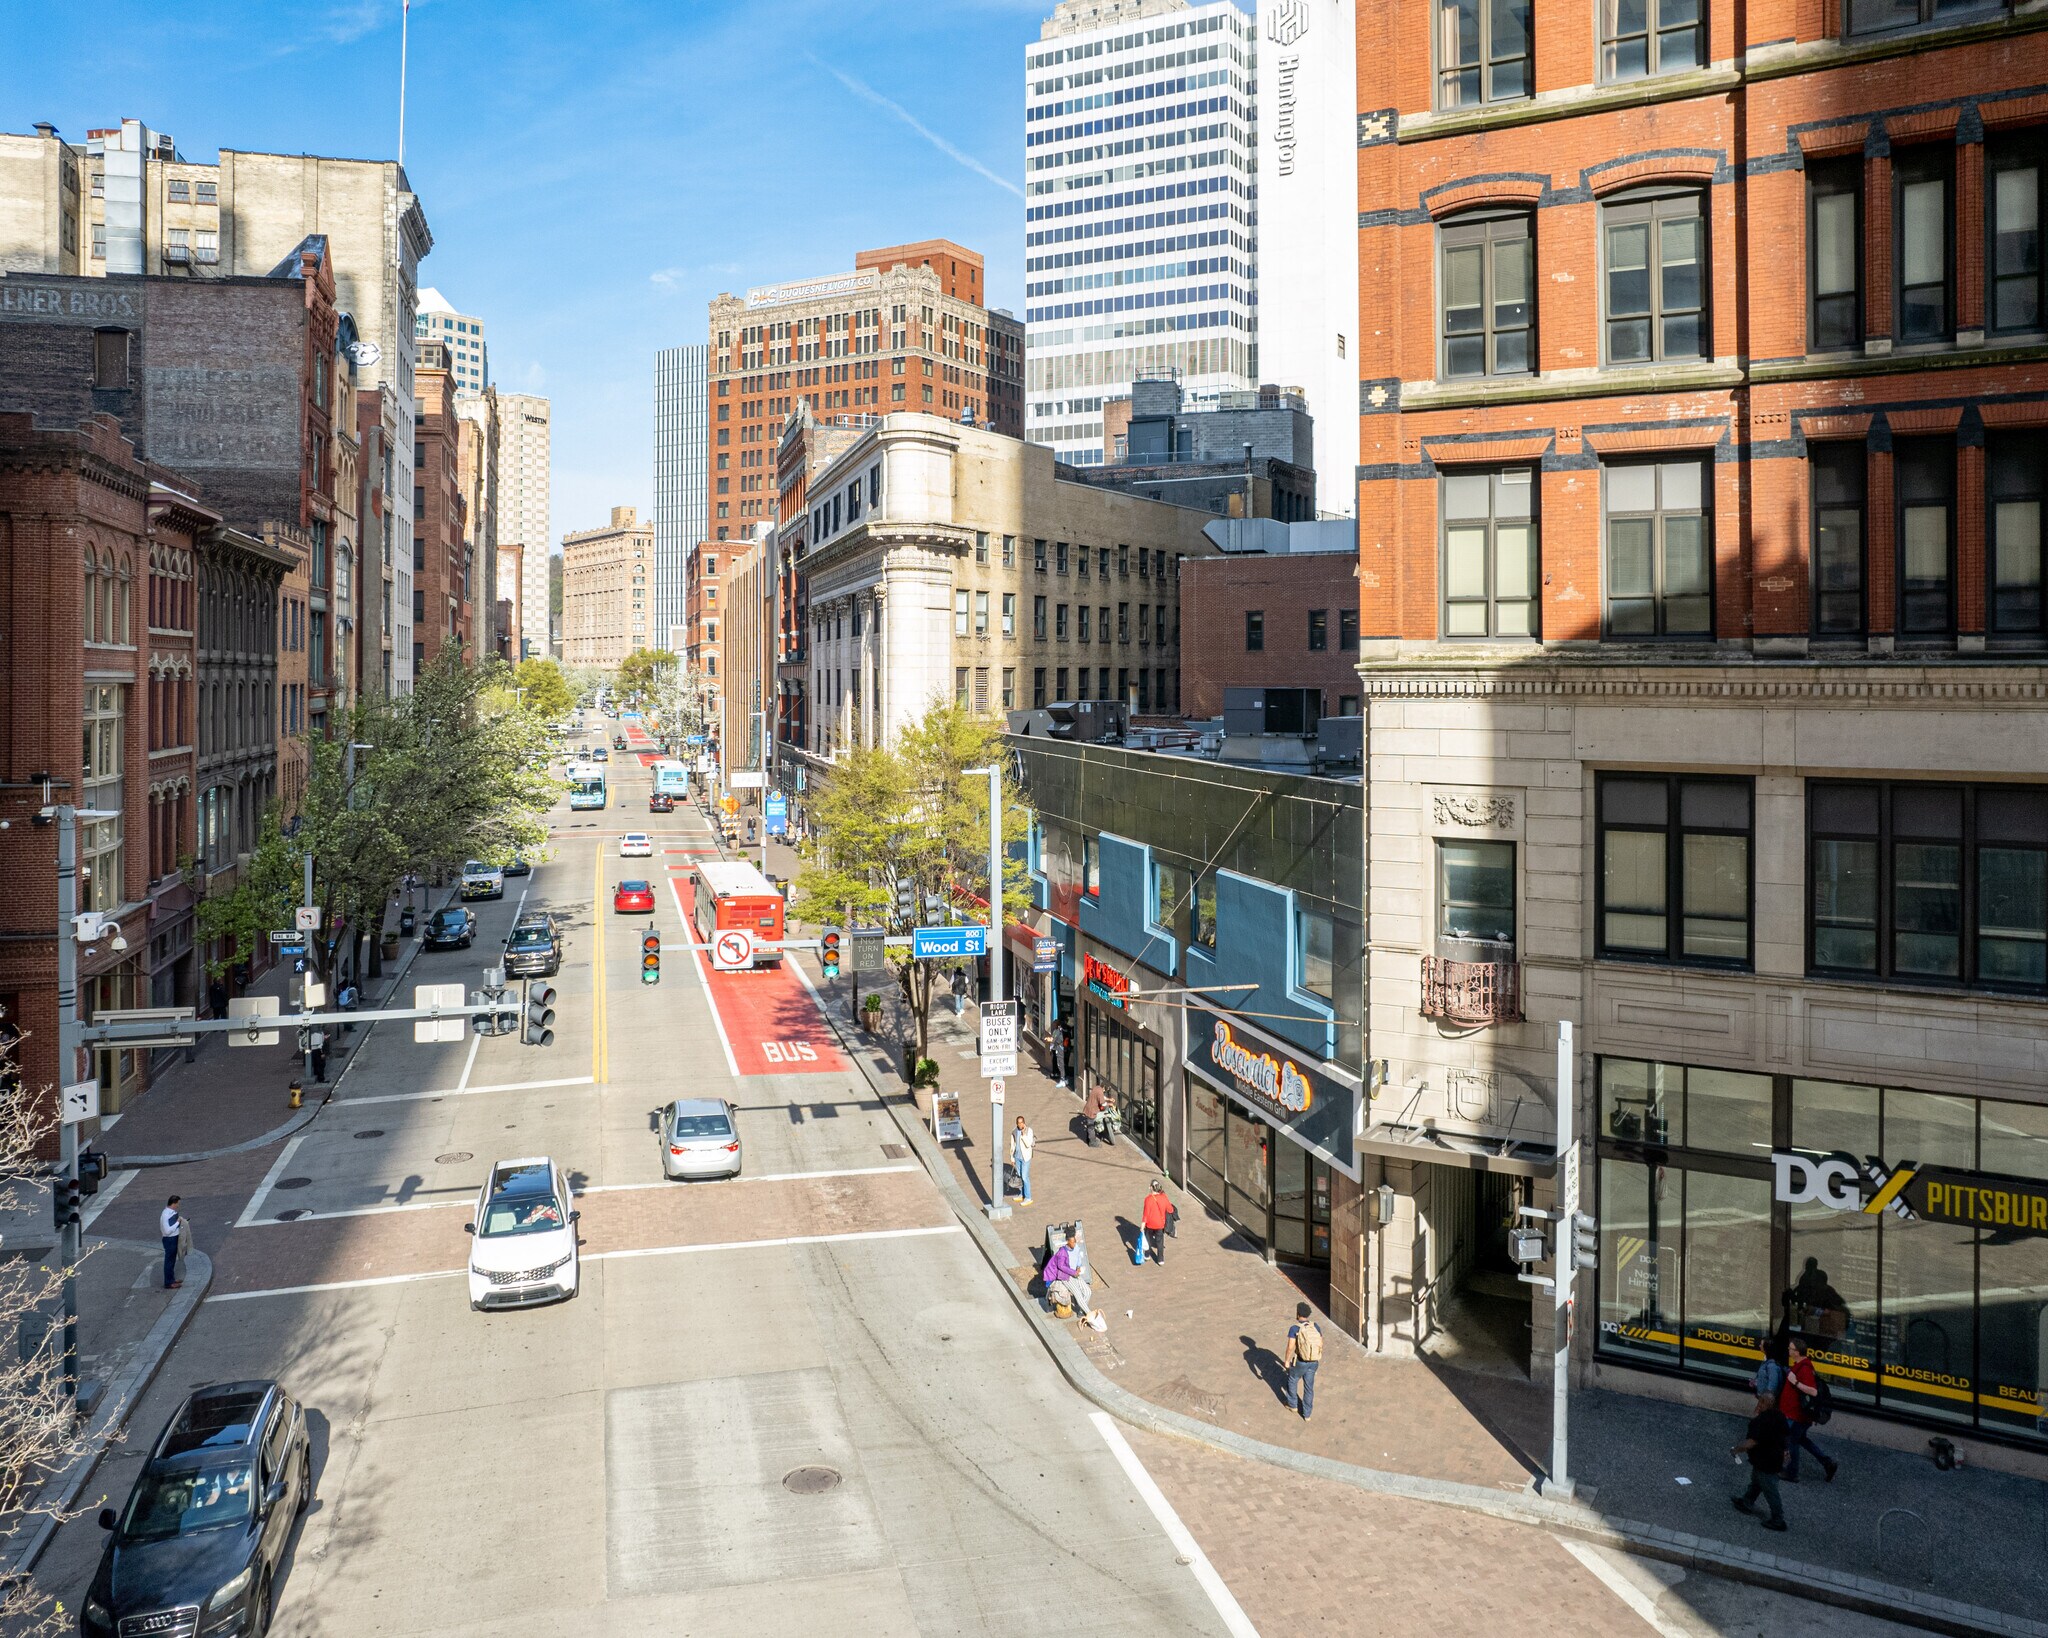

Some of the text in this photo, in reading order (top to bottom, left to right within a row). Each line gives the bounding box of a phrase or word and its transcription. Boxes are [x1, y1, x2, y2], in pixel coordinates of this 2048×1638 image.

[1275, 55, 1299, 176] Huntington
[0, 287, 135, 317] LNER BROS.
[750, 276, 873, 308] DLC DUQUESNE LIGHT CO.
[860, 937, 876, 945] NO
[965, 930, 980, 938] 600
[921, 940, 980, 953] Wood St
[986, 1018, 1012, 1027] BUSES
[988, 1028, 1009, 1036] ONLY
[762, 1041, 819, 1063] BUS
[1211, 1020, 1280, 1100] Rosewater
[1253, 1090, 1273, 1111] Eastern
[1274, 1102, 1287, 1119] Grill
[1771, 1153, 1917, 1220] DGX
[1640, 1255, 1658, 1264] DGX
[1628, 1276, 1658, 1291] Hiring
[1634, 1269, 1658, 1280] Now
[1697, 1328, 1755, 1347] PRODUCE
[1806, 1348, 1869, 1369] ROCERIES
[1885, 1363, 1970, 1388] HOUSEHOLD
